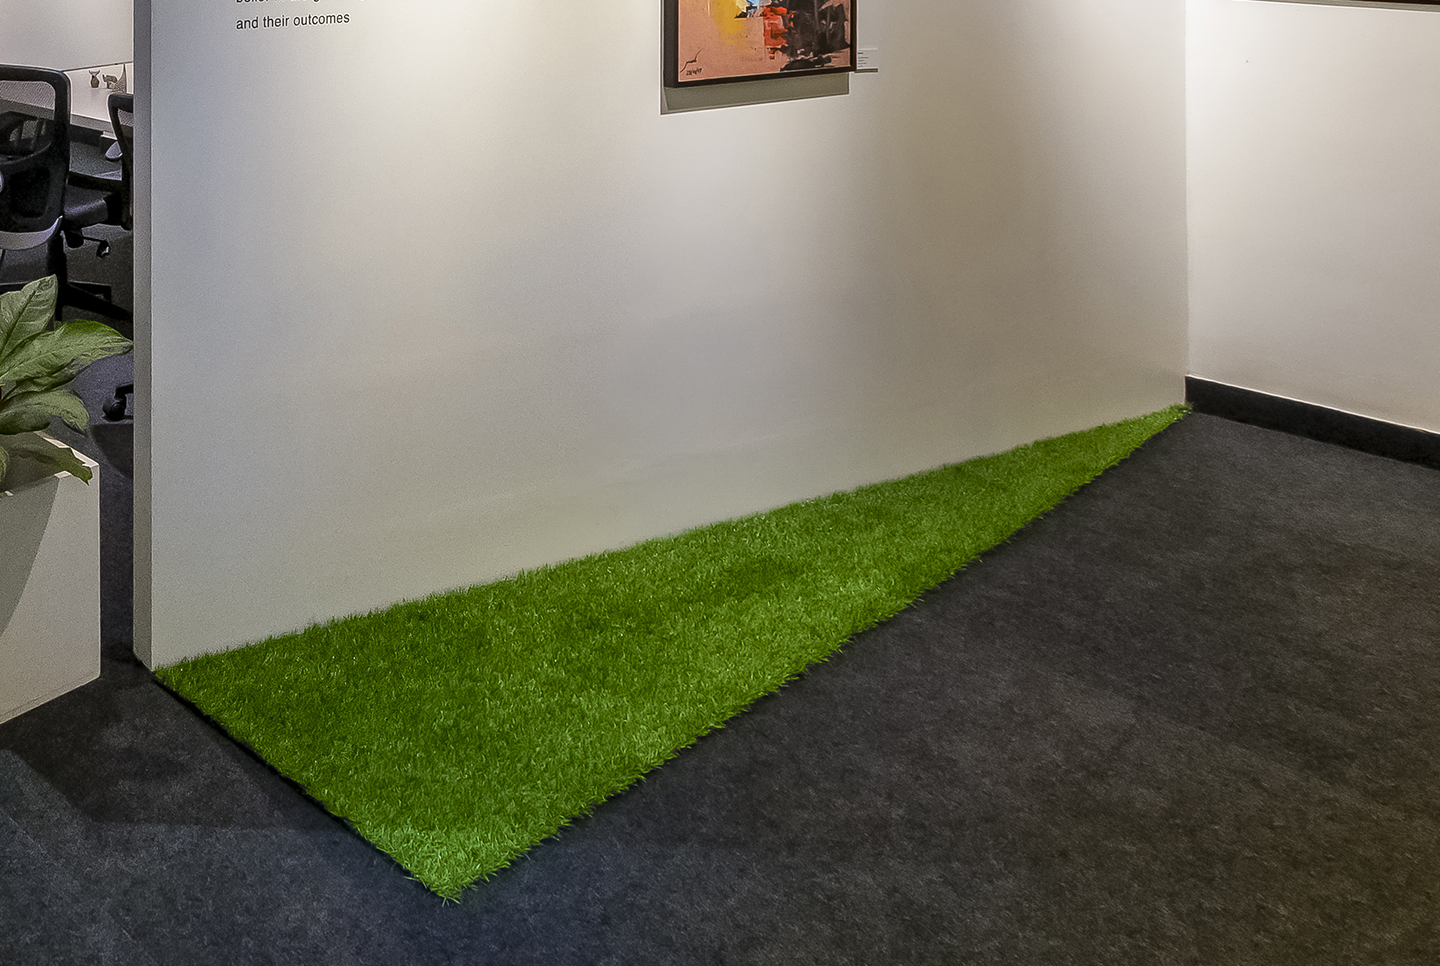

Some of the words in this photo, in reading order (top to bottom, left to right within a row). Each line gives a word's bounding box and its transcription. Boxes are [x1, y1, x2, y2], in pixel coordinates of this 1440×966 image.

[236, 16, 258, 30] and
[263, 15, 290, 28] their
[293, 14, 350, 26] outcomes
